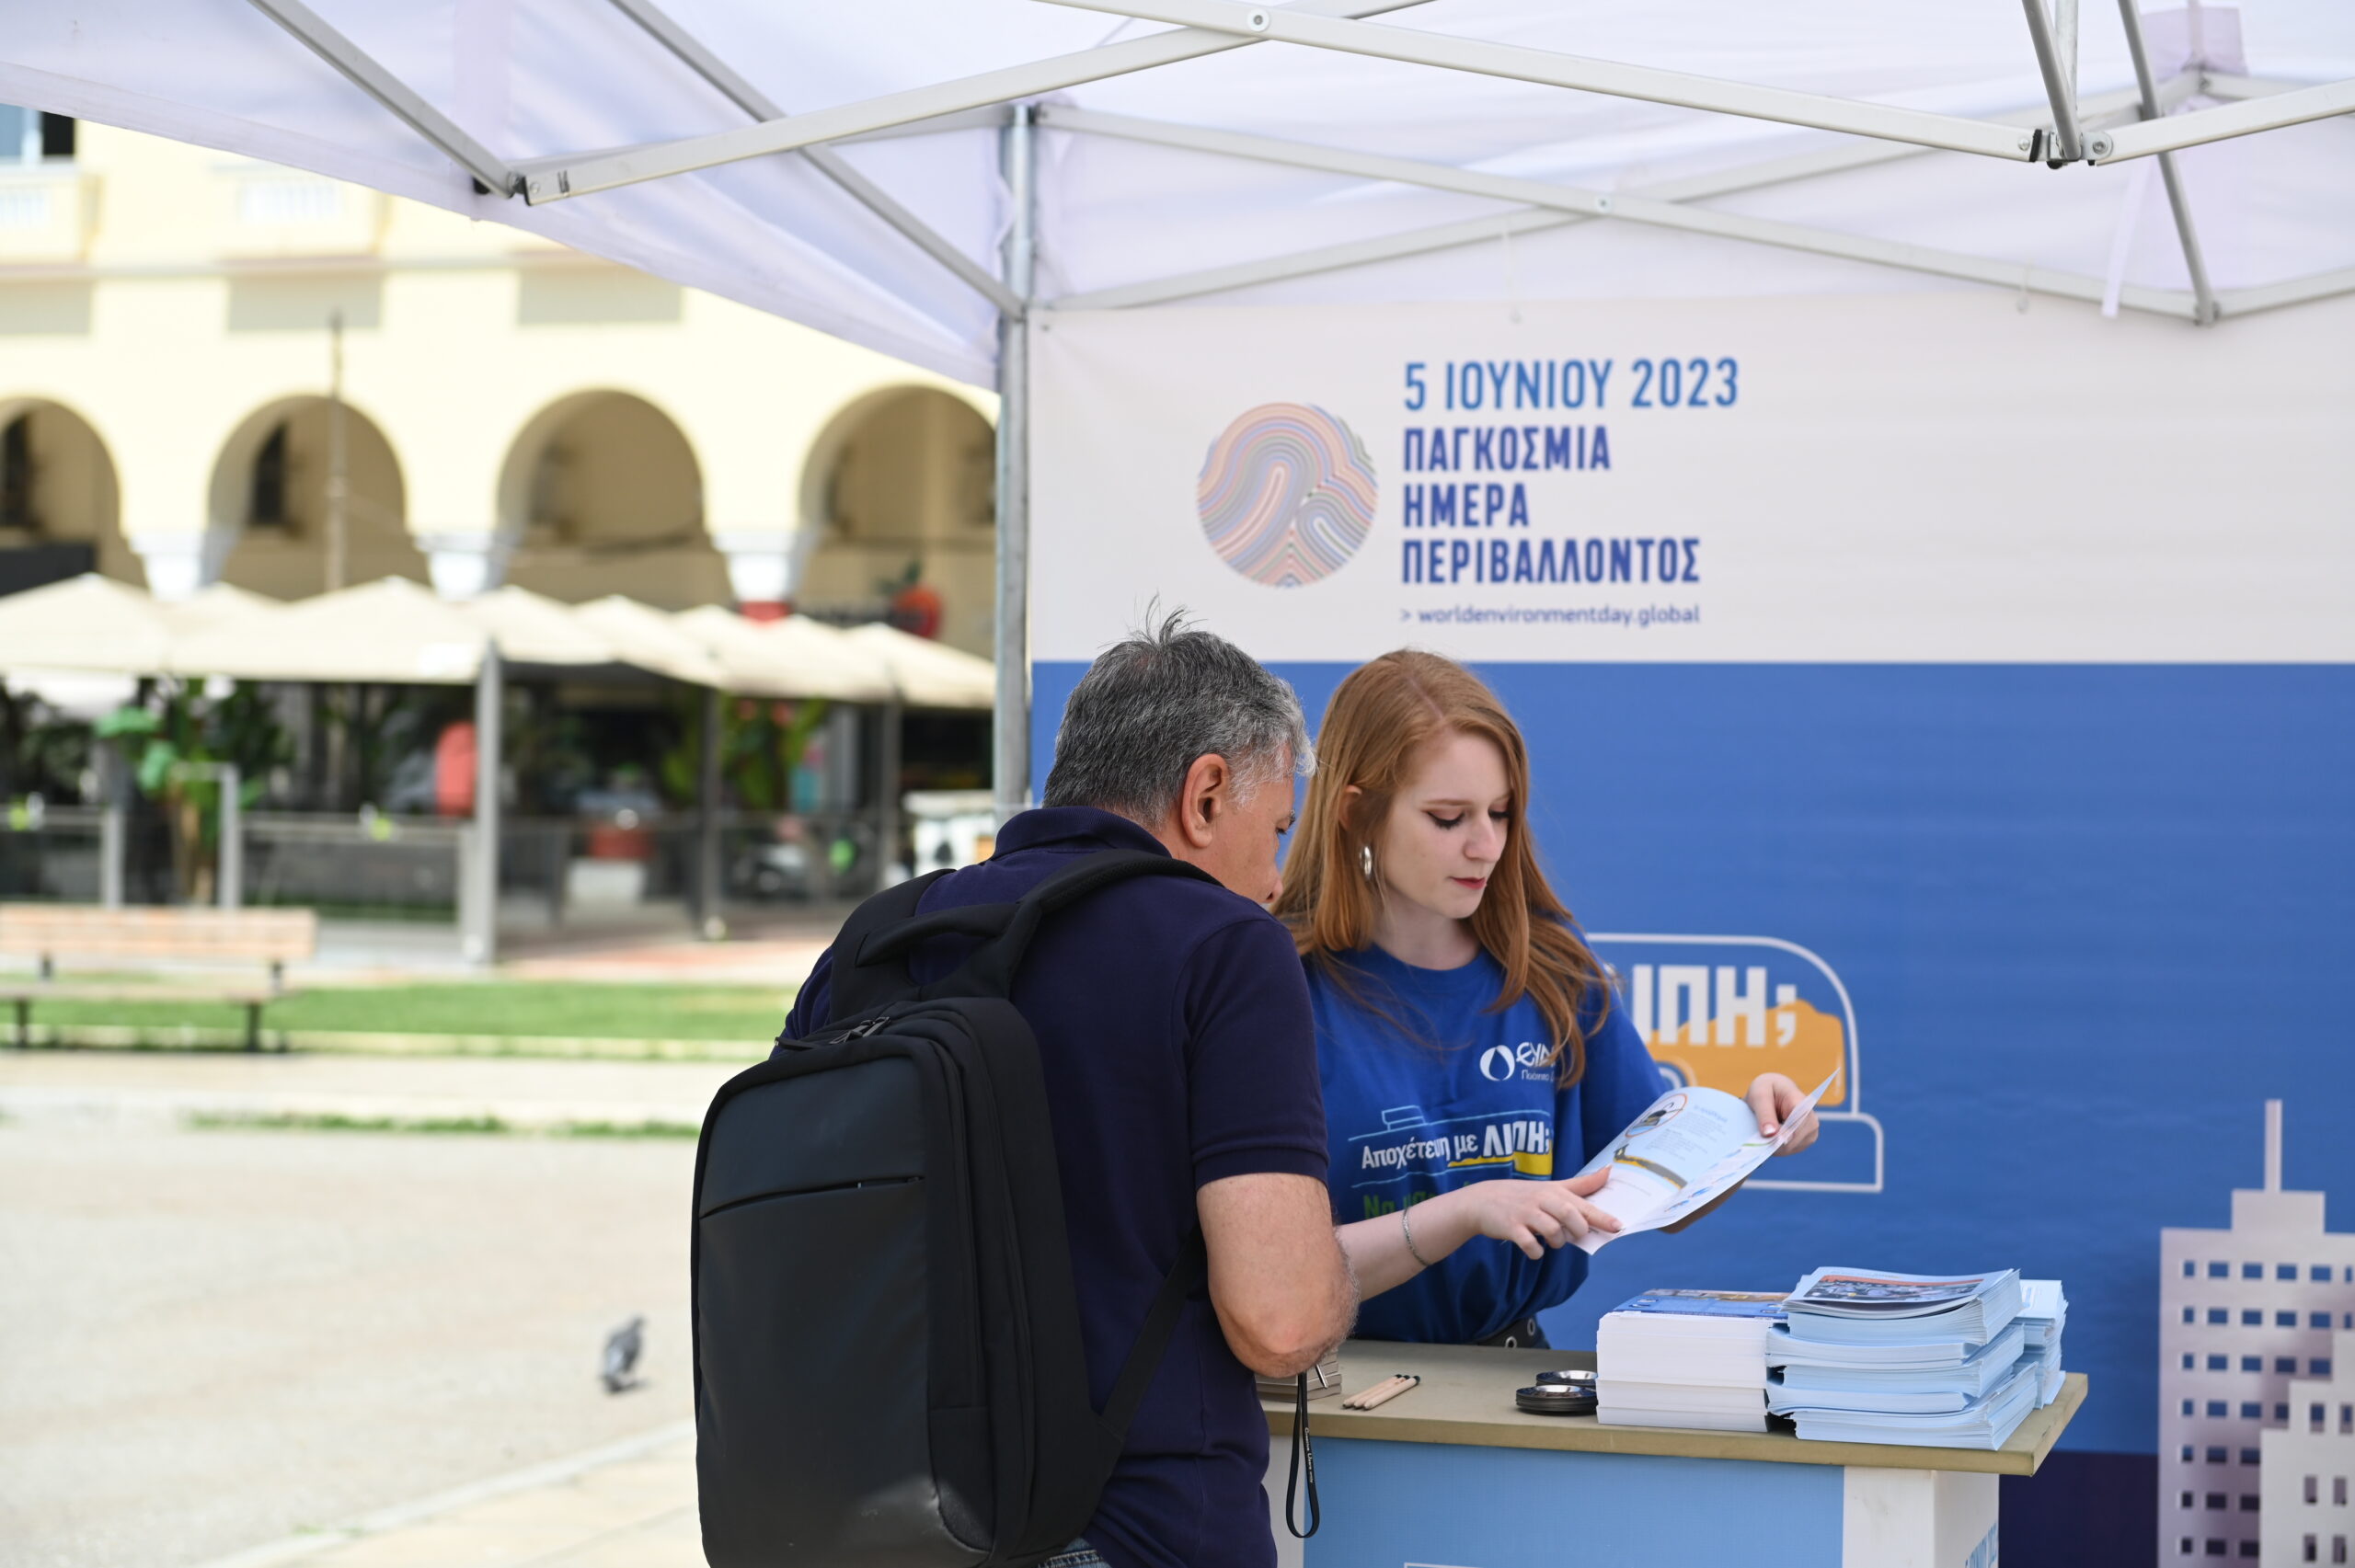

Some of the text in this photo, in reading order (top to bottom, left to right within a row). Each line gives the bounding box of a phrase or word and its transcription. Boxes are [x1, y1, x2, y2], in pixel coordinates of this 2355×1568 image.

[1404, 357, 1738, 411] 5 ΙΟΥΝΙΟΥ 2023
[1404, 425, 1611, 471] ΠΑΓΚΟΣΜΙΑ
[1403, 482, 1529, 527] ΗΜΕΡΑ
[1402, 537, 1700, 584] ΠΕΡΙΒΑΛΛΟΝΤΟΣ
[1418, 604, 1700, 628] worldenvironmentday.global
[1604, 963, 1798, 1047] ΙΠΗ;
[1454, 1133, 1478, 1160] με
